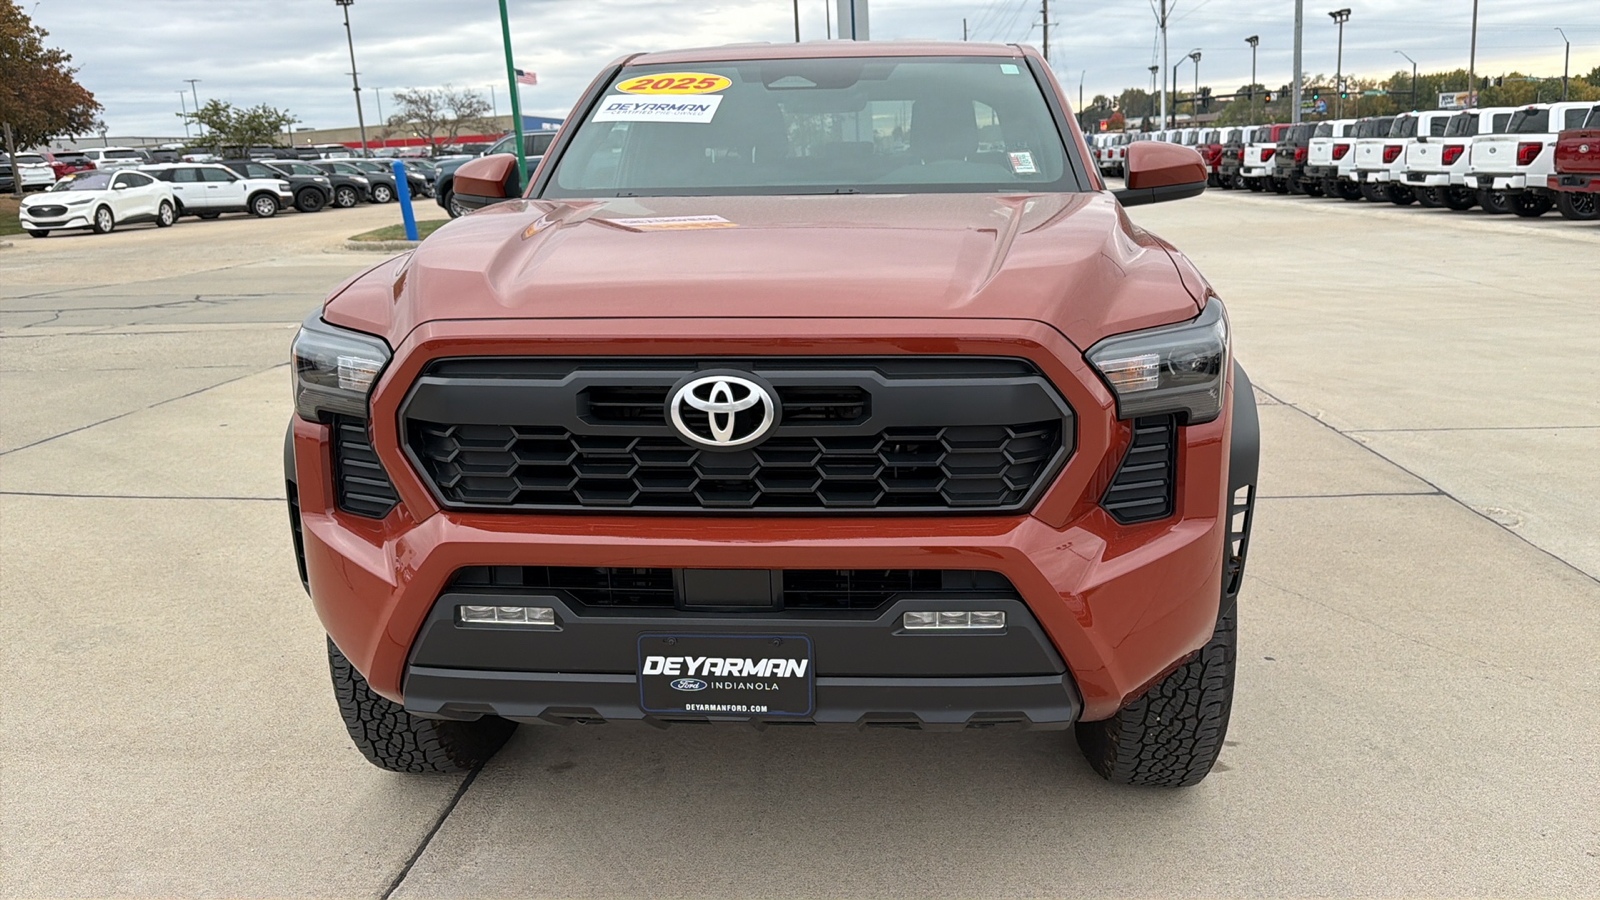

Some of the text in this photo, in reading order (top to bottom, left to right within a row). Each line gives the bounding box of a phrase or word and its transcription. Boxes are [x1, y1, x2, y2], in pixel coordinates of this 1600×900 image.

[626, 77, 720, 91] 2025
[605, 103, 711, 112] DEYARMAN
[642, 656, 809, 678] DEYARMAN
[677, 680, 779, 691] Ford INDIANOLA
[685, 703, 768, 713] DEYARMANFORD.COM
